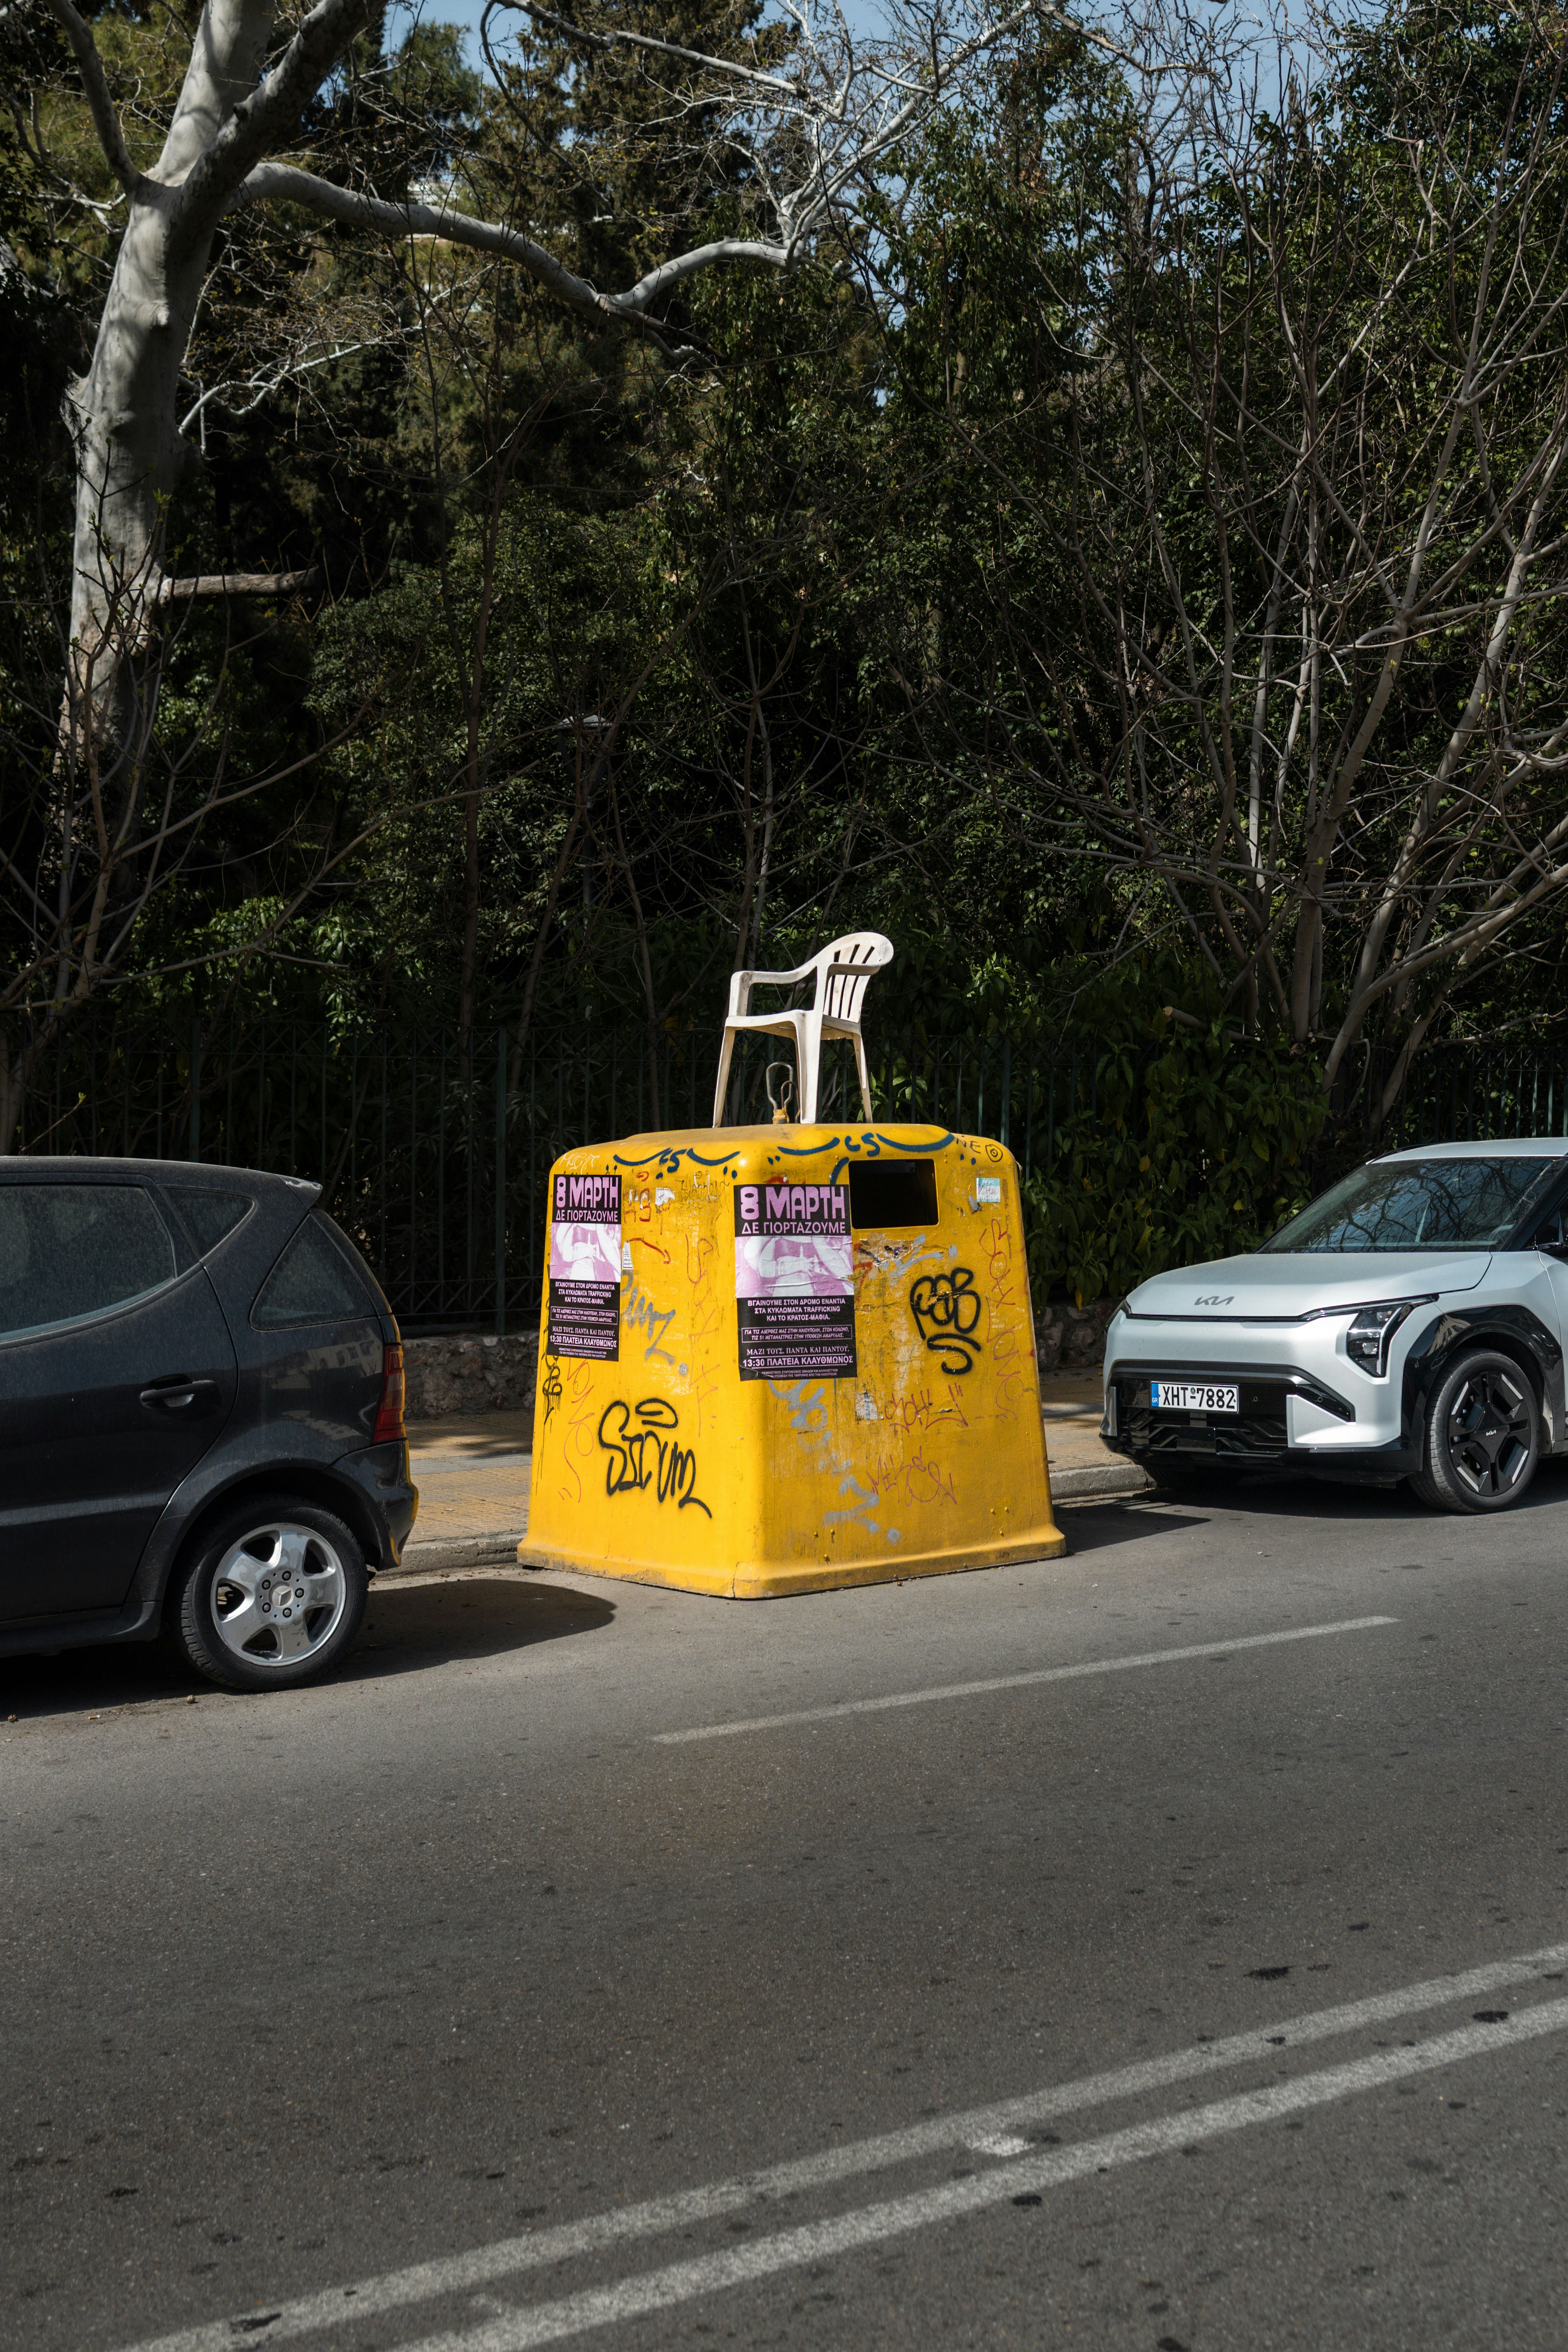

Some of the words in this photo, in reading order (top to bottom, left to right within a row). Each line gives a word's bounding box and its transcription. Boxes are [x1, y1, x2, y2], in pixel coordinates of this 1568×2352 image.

[556, 1176, 566, 1208] 8
[569, 1177, 618, 1208] ΜΑΡΤΗ
[740, 1186, 759, 1220] 8
[765, 1186, 845, 1219] ΜΑΡΤΗ
[556, 1210, 565, 1220] ΔΕ
[567, 1210, 618, 1222] ΓΙΟΡΤΑΖΟΥΜΕ
[741, 1222, 759, 1234] ΔΕ
[764, 1222, 846, 1234] ΓΙΟΡΤΑΖΟΥΜΕ
[1194, 1296, 1235, 1305] KIA
[563, 1336, 582, 1345] ΠΛΑΤΕΙΑ
[584, 1338, 617, 1347] ΚΛΑΥΘΜΩΝΟΣ
[743, 1359, 765, 1367] 13:30
[767, 1357, 799, 1366] ΠΛΑΤΕΙΑ
[801, 1356, 853, 1364] ΚΛΑΥΘΜΩΝΟΣ
[1163, 1386, 1235, 1409] XHT-7882
